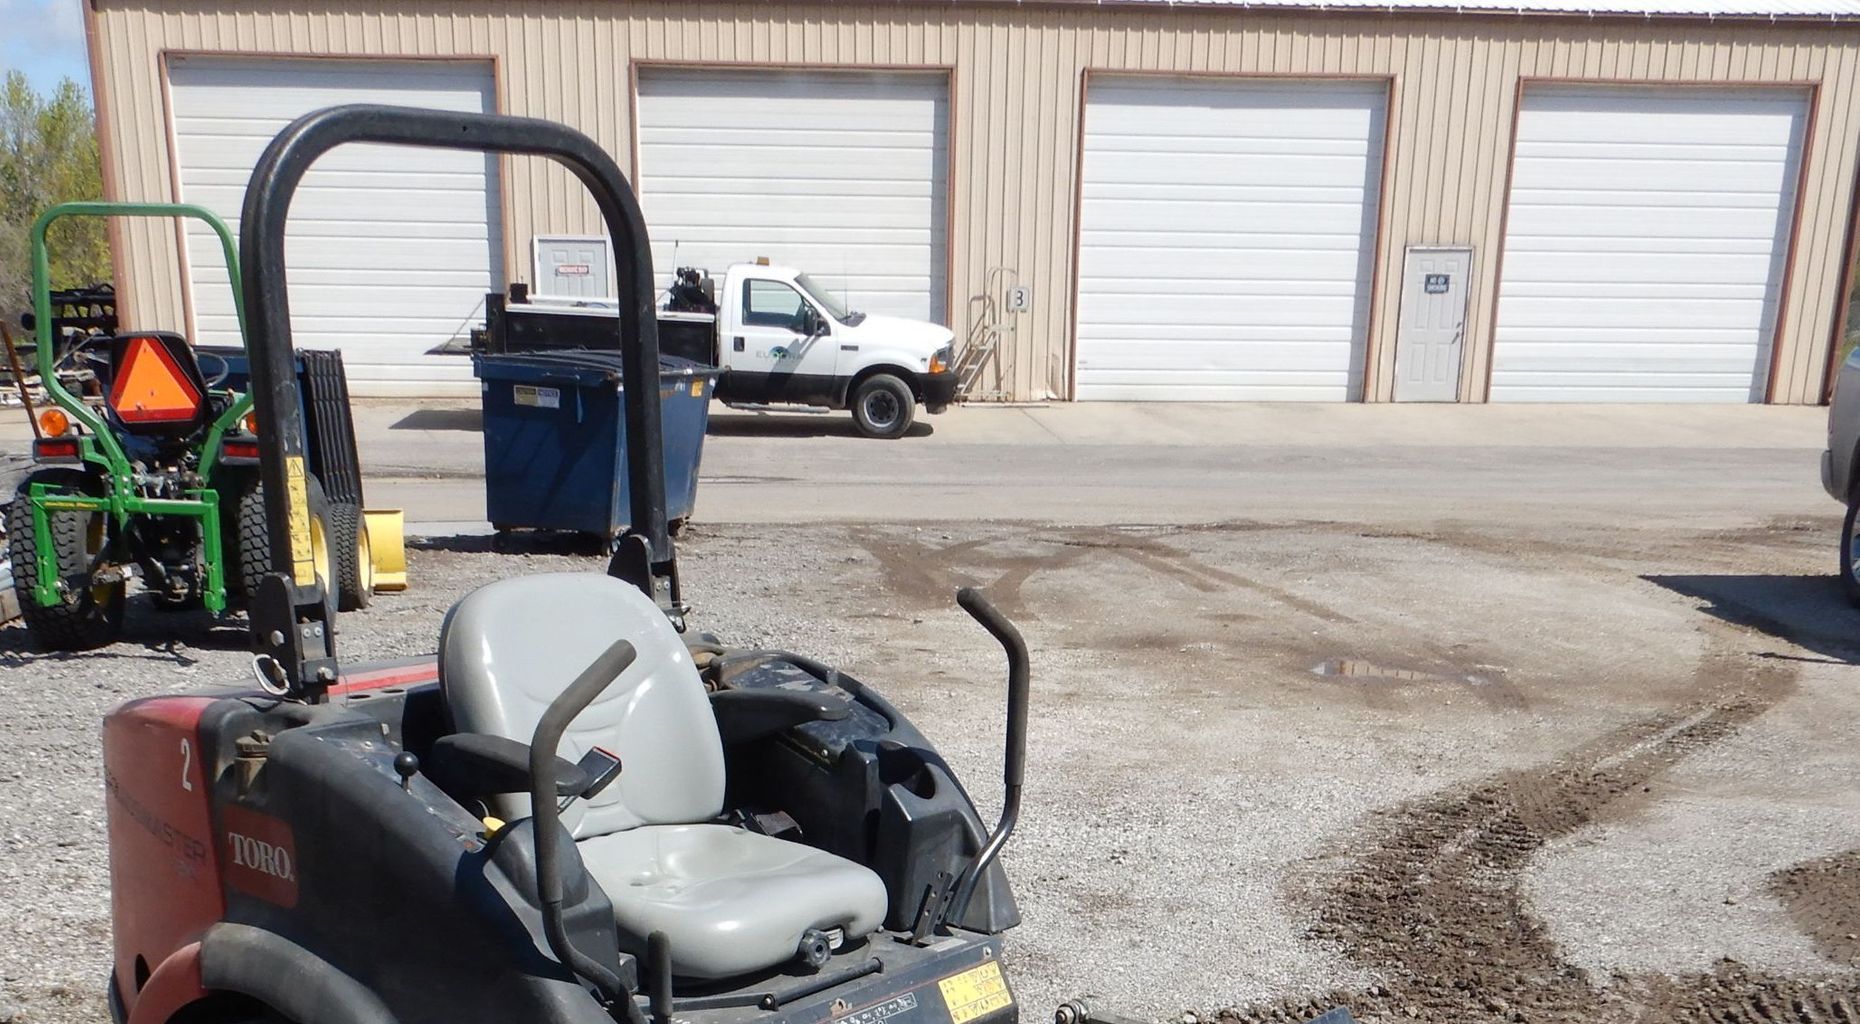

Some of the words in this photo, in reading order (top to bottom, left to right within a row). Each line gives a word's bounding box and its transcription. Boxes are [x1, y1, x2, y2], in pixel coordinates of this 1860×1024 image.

[1016, 290, 1024, 306] 3
[181, 737, 192, 792] 2
[228, 832, 293, 880] TORO
